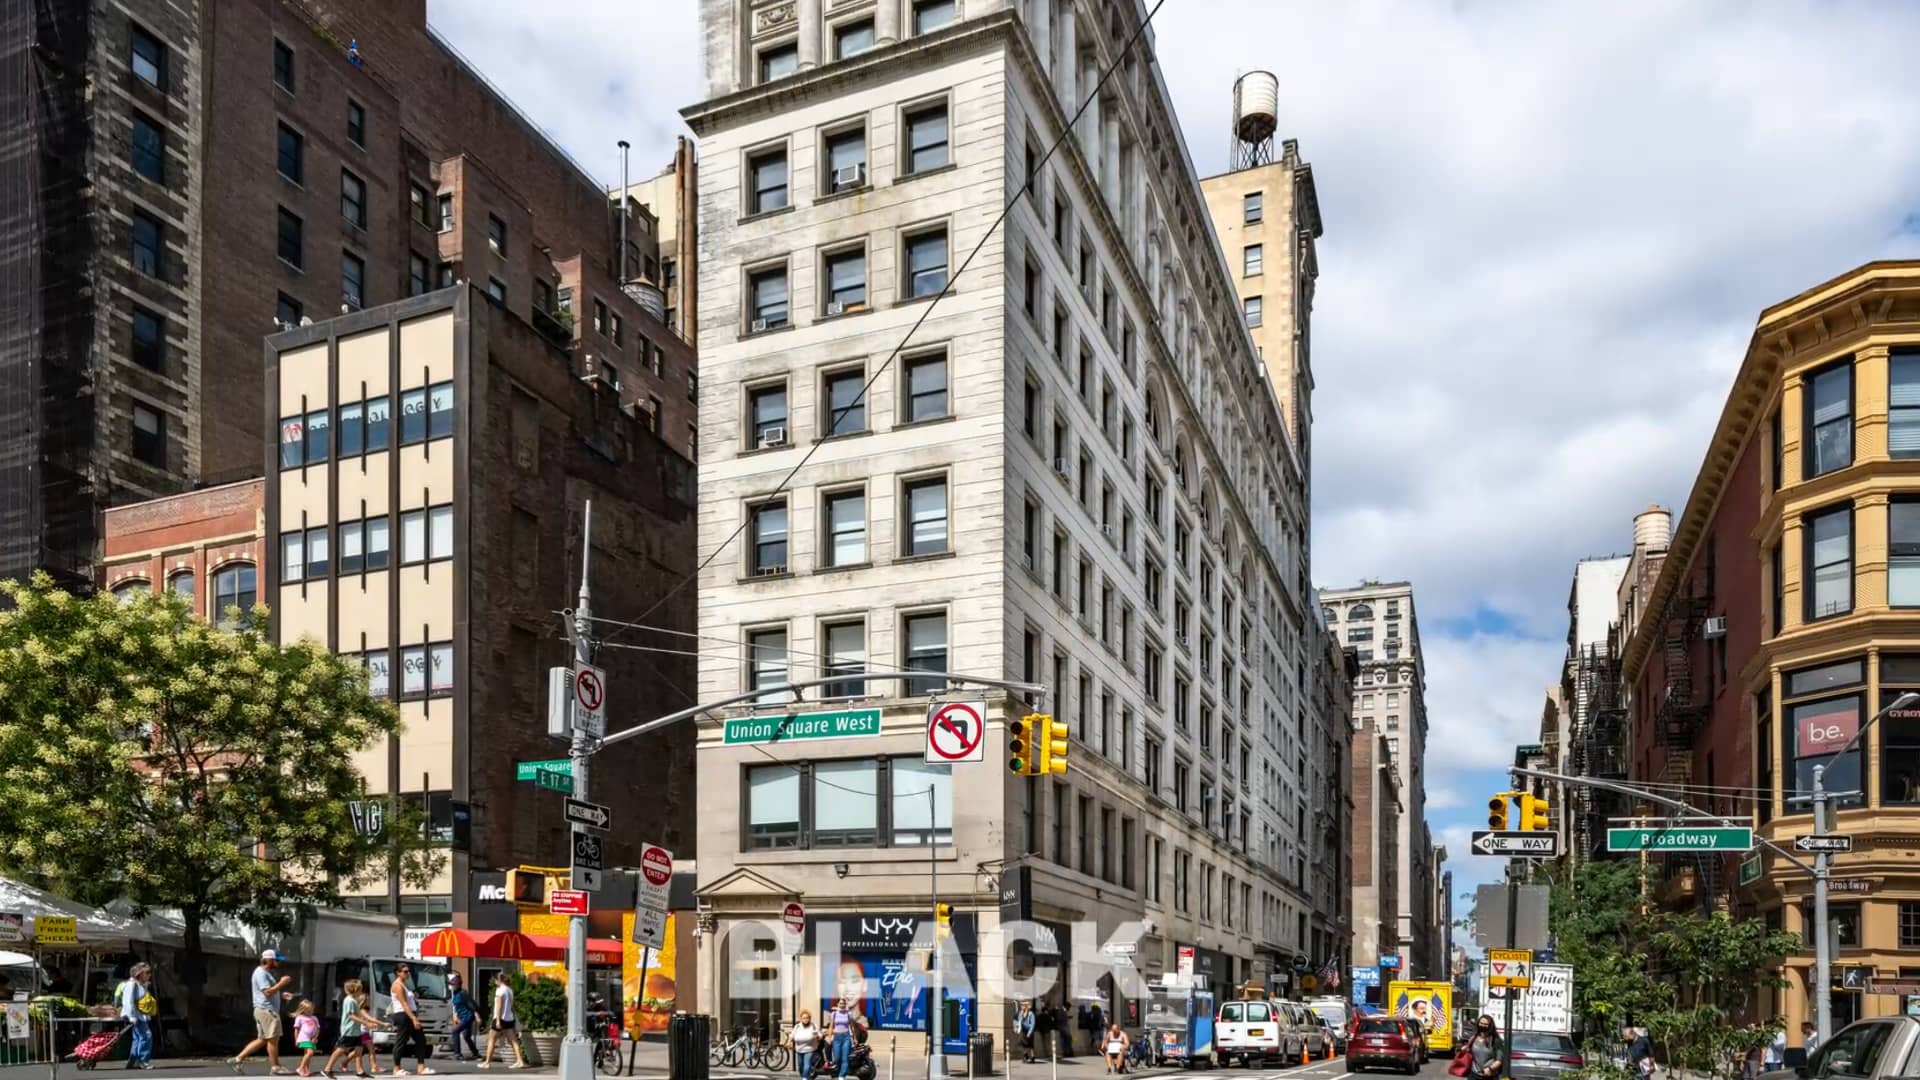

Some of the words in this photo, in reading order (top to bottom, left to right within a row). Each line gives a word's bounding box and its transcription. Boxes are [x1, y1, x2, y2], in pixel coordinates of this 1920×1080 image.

[731, 720, 772, 739] Union
[778, 717, 828, 740] Square
[836, 713, 872, 731] West
[541, 771, 546, 785] E
[550, 774, 559, 788] 17
[572, 806, 584, 817] ONE
[591, 810, 605, 822] WAY
[1483, 838, 1507, 849] ONE
[1522, 839, 1549, 849] WAY
[1641, 832, 1717, 848] Broadway
[1802, 839, 1816, 847] ONE
[646, 852, 655, 860] DO
[656, 855, 668, 864] NOT
[647, 868, 665, 880] ENTER
[645, 910, 658, 920] ALL
[42, 917, 70, 925] FARM
[40, 926, 73, 934] FRESH
[861, 918, 912, 940] NYX
[34, 934, 79, 942] CHEESE
[406, 932, 419, 940] FOR
[842, 940, 899, 948] PROFESSIONAL
[1493, 952, 1528, 961] CYCLISTS
[1353, 971, 1379, 981] Park
[1533, 973, 1564, 985] hite
